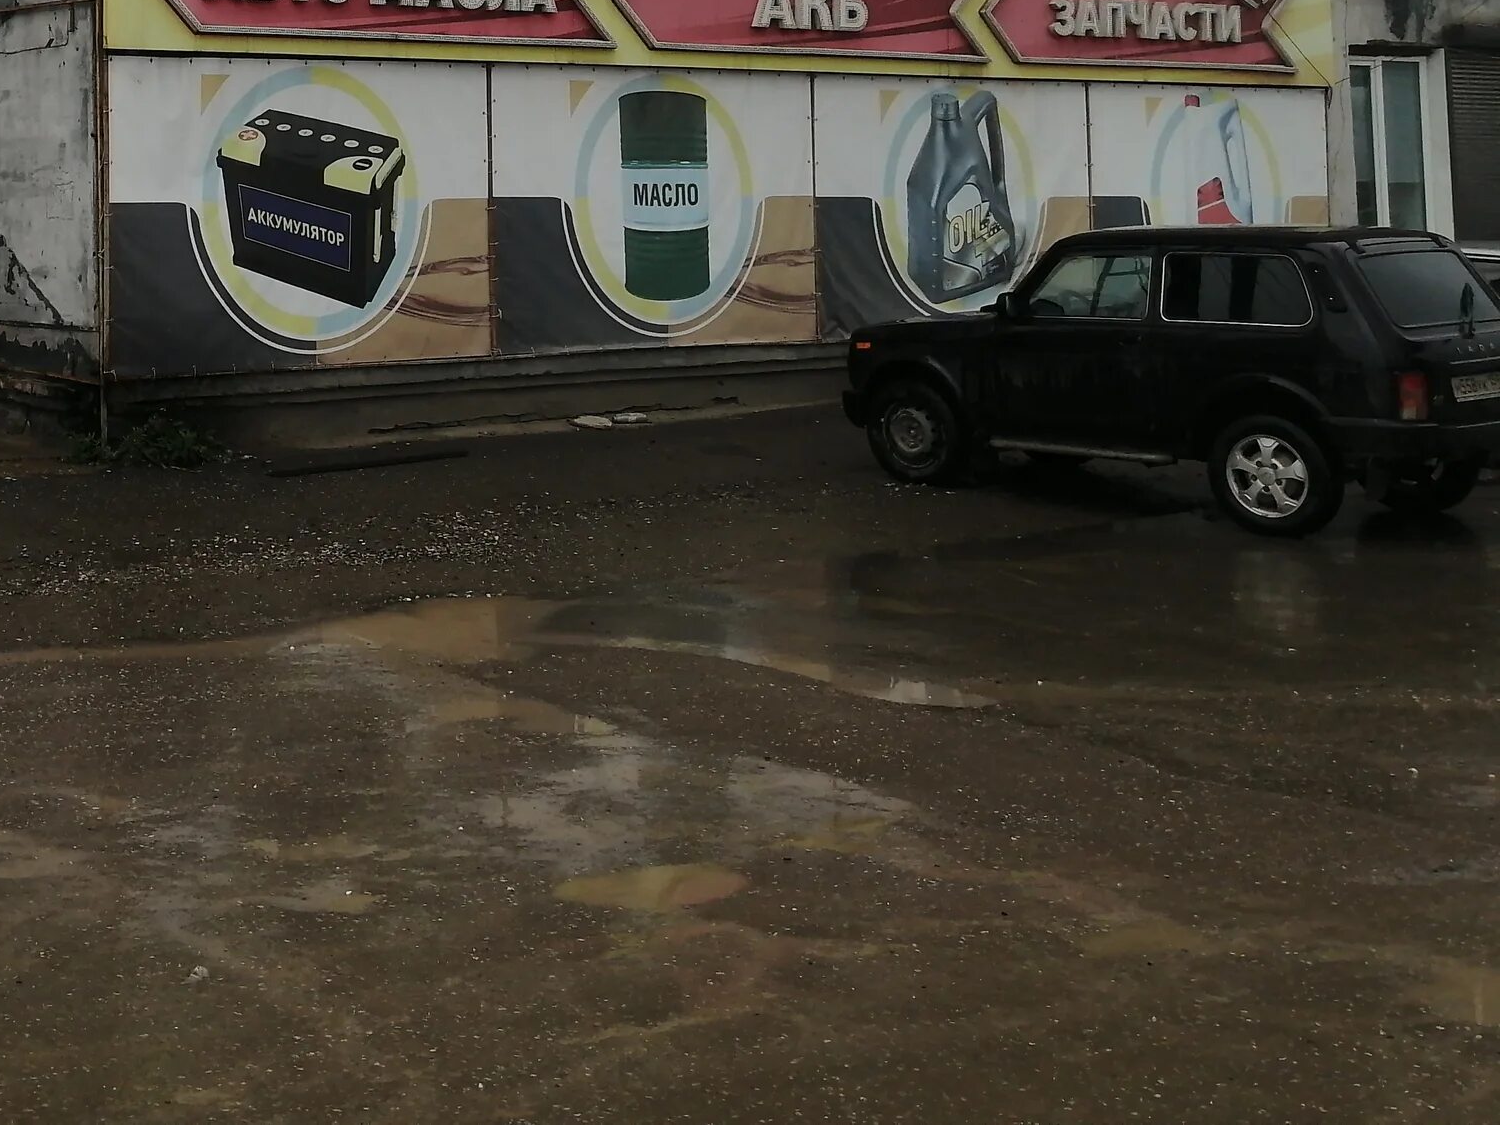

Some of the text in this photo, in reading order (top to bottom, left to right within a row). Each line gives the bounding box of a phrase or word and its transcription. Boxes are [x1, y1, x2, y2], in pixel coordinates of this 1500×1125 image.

[632, 182, 699, 208] МАСЛО
[247, 206, 346, 248] АККУМУЛЯТОР
[948, 204, 988, 254] OIL
